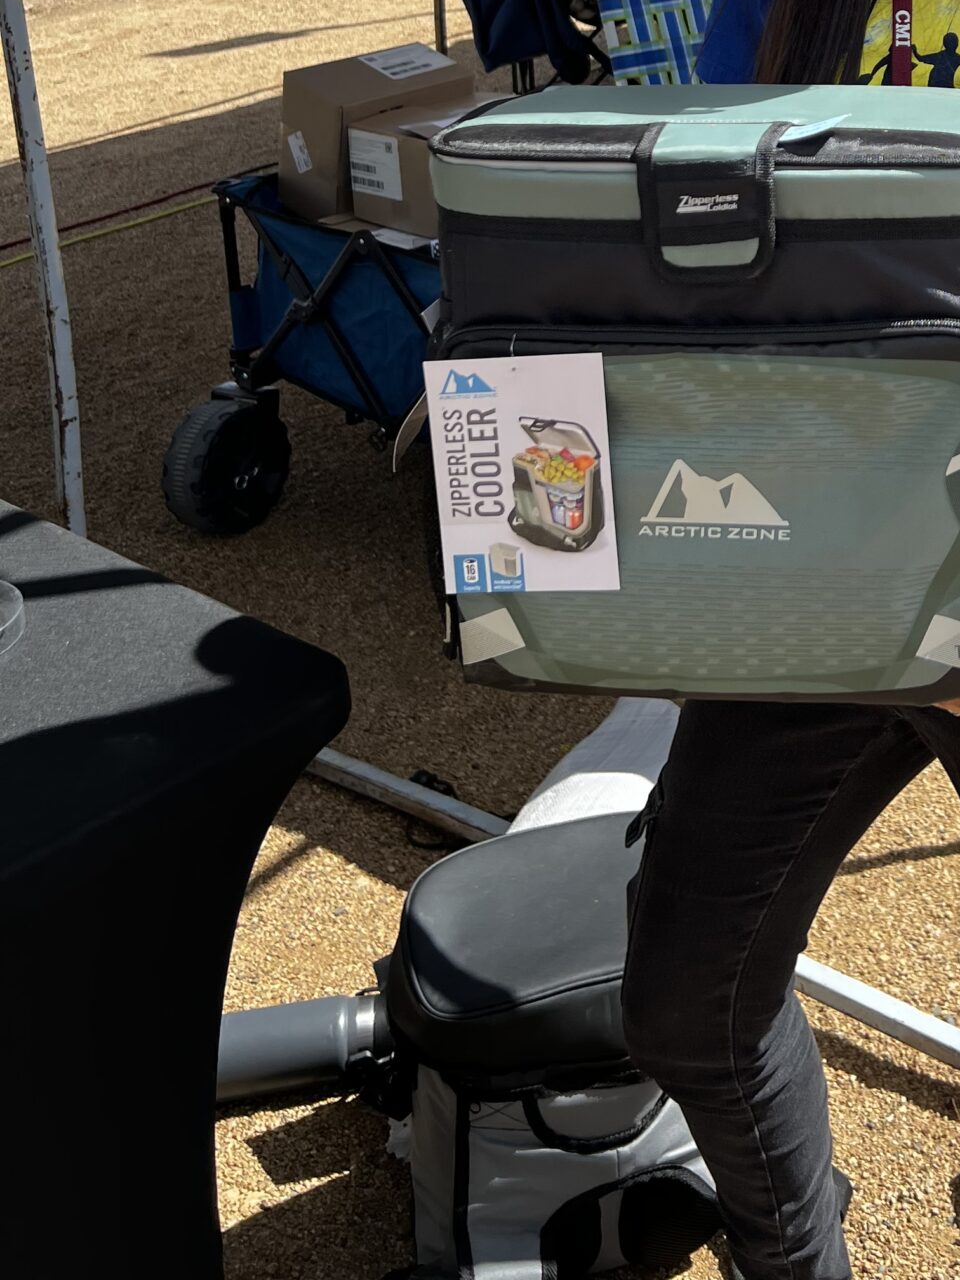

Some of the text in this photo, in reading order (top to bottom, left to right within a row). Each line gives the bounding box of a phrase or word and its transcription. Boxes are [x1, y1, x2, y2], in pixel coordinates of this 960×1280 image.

[895, 10, 911, 48] CMI
[679, 194, 739, 208] Zipperless
[443, 408, 472, 518] ZIPPERLESS
[466, 407, 506, 518] COOLER
[638, 525, 792, 541] ARCTIC ZONE
[465, 564, 476, 575] 16
